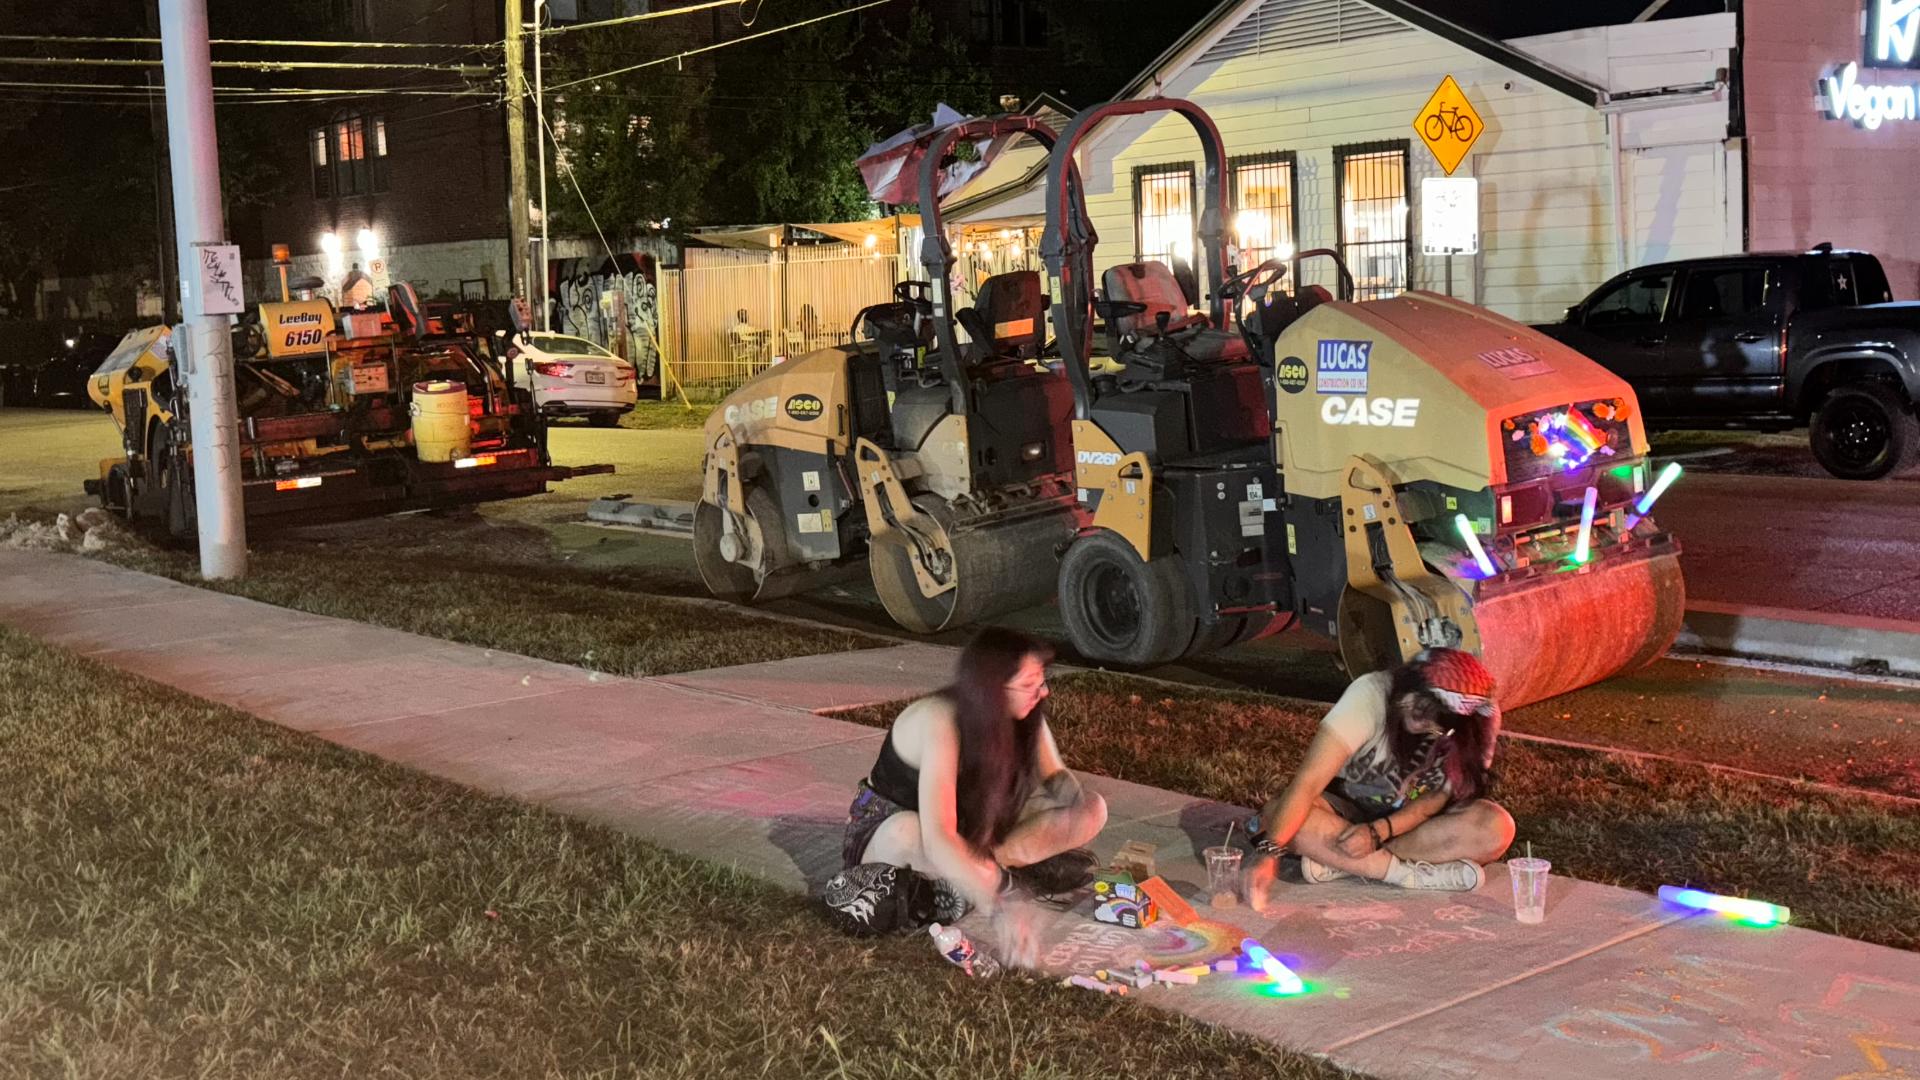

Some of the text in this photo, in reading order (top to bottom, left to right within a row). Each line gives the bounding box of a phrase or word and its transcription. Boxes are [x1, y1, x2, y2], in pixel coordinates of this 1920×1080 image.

[1828, 61, 1915, 129] Vegan
[279, 312, 322, 325] LeeBoy
[285, 329, 322, 347] 6150
[1319, 343, 1367, 370] LUCAS
[1279, 365, 1306, 378] ASCO
[724, 396, 778, 425] CASE
[787, 399, 821, 410] ASCO
[1321, 396, 1420, 427] CASE
